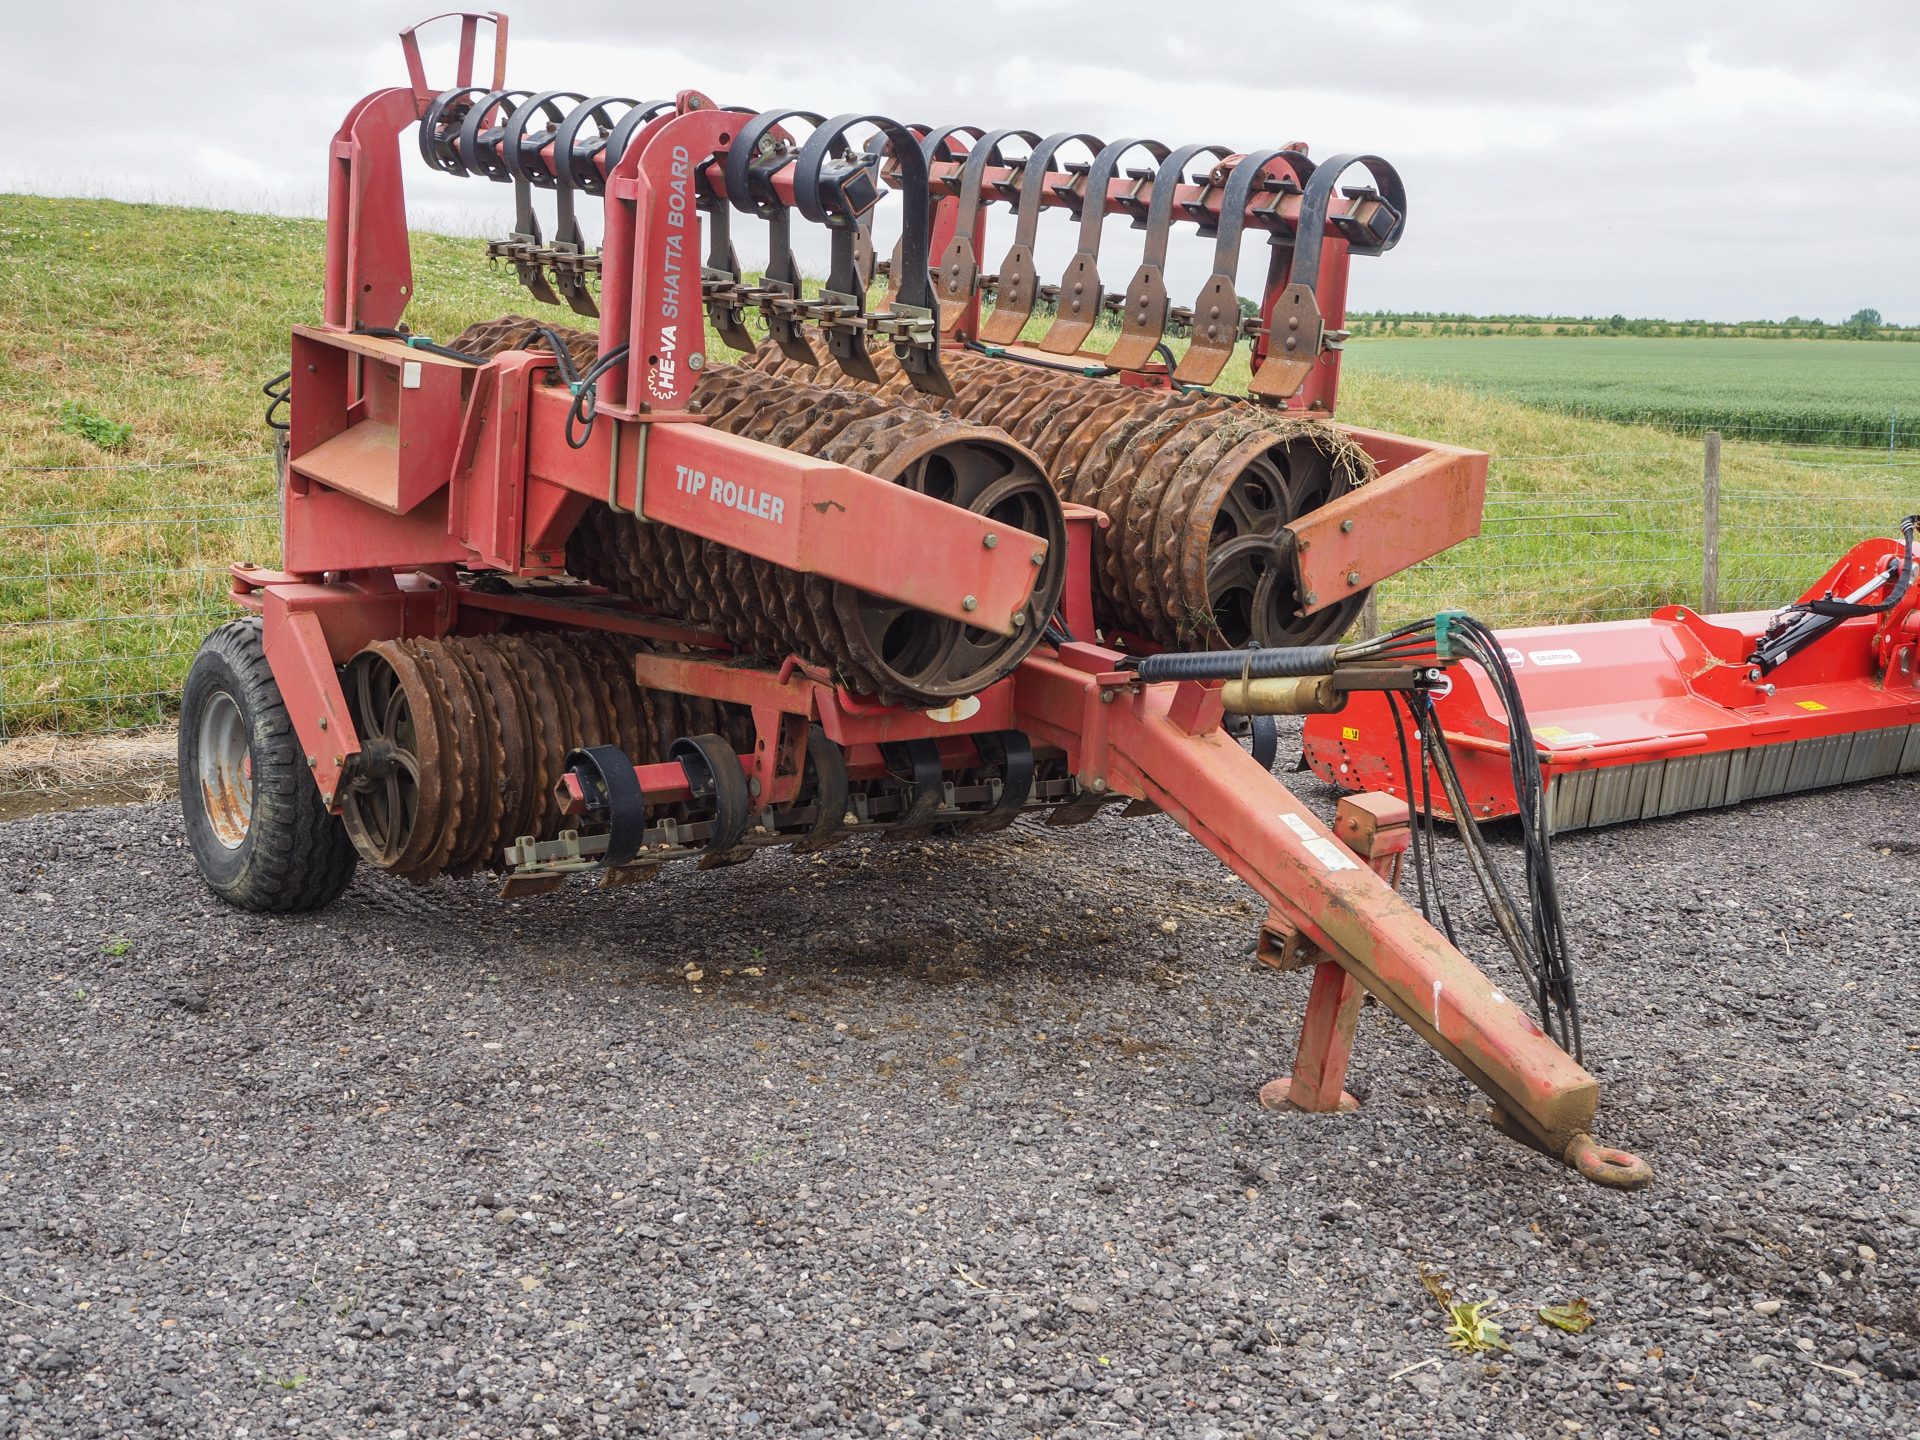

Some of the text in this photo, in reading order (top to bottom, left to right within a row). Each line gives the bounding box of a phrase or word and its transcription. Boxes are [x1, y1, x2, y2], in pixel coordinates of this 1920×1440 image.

[658, 145, 689, 390] HE-VA SHATTA BOARD
[676, 464, 785, 525] TIP ROLLER
